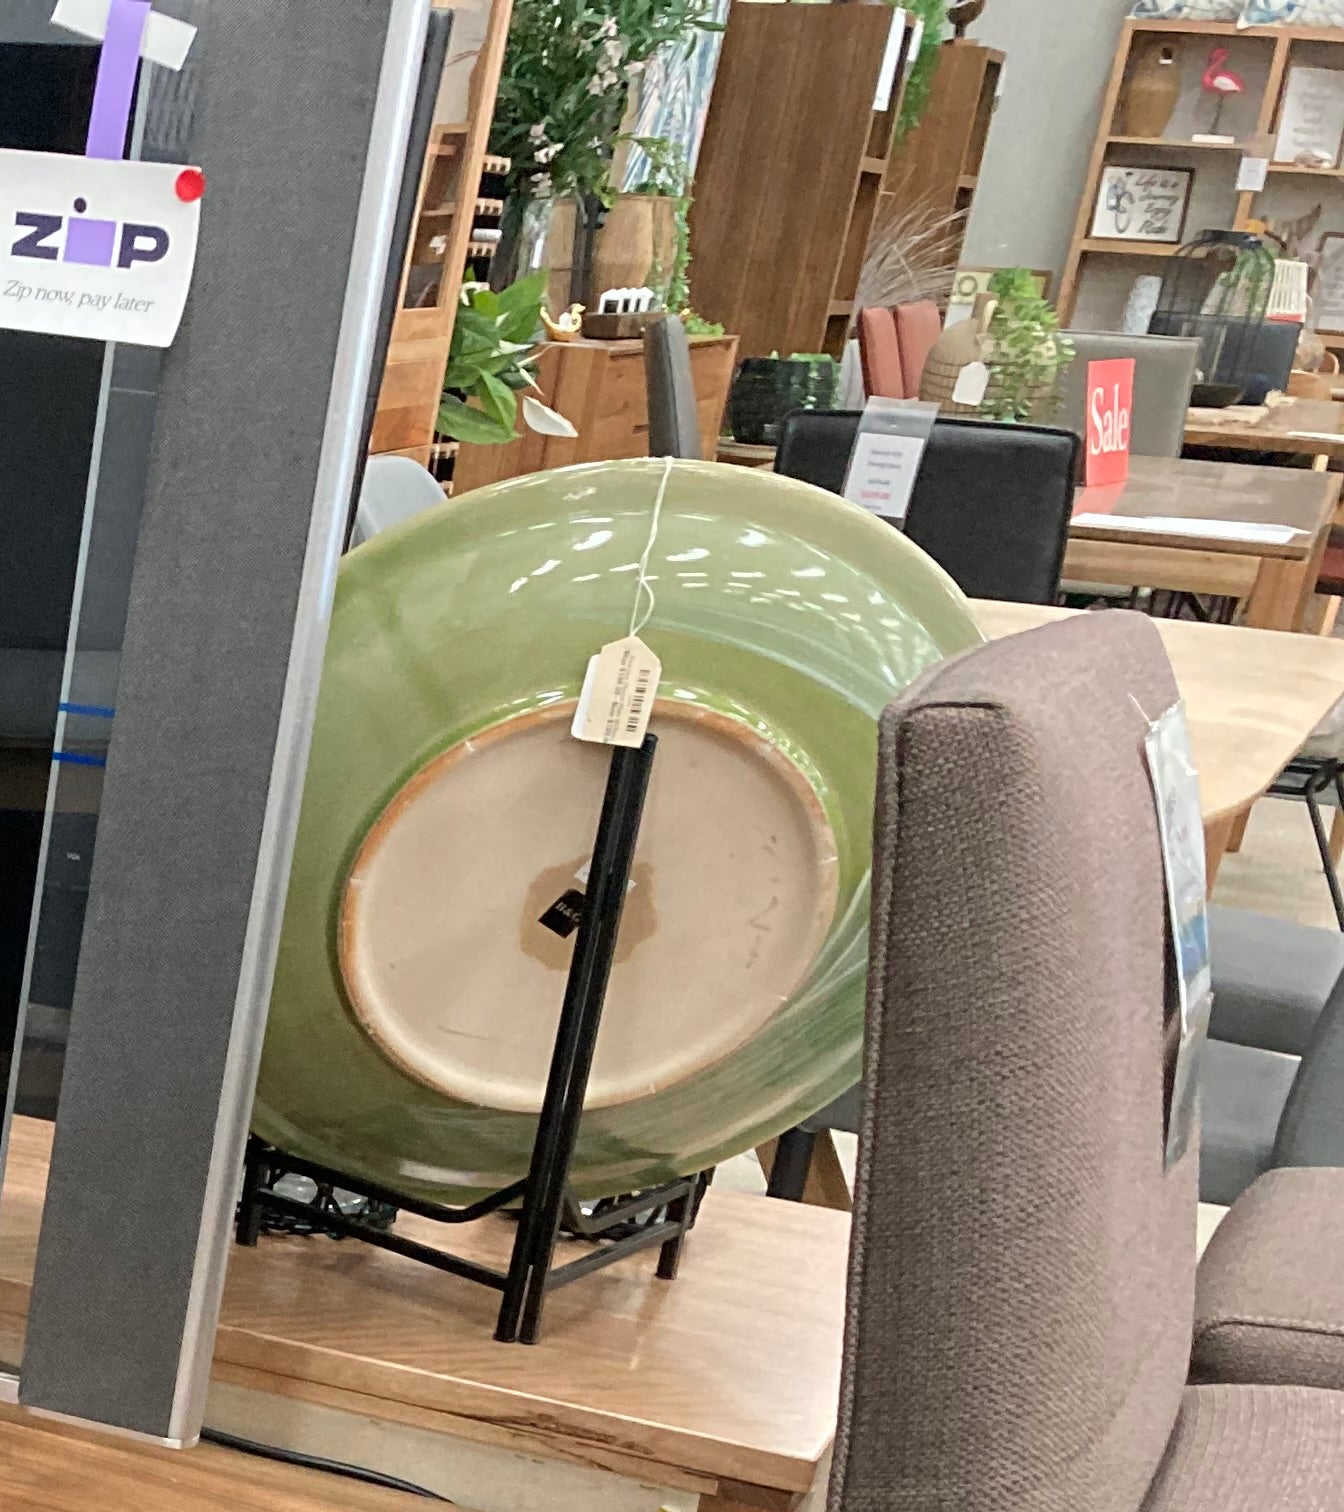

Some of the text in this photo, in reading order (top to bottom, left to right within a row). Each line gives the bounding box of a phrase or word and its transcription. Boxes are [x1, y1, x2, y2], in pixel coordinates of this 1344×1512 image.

[2, 279, 155, 313] Zip now, pay later
[1090, 382, 1129, 456] Sale
